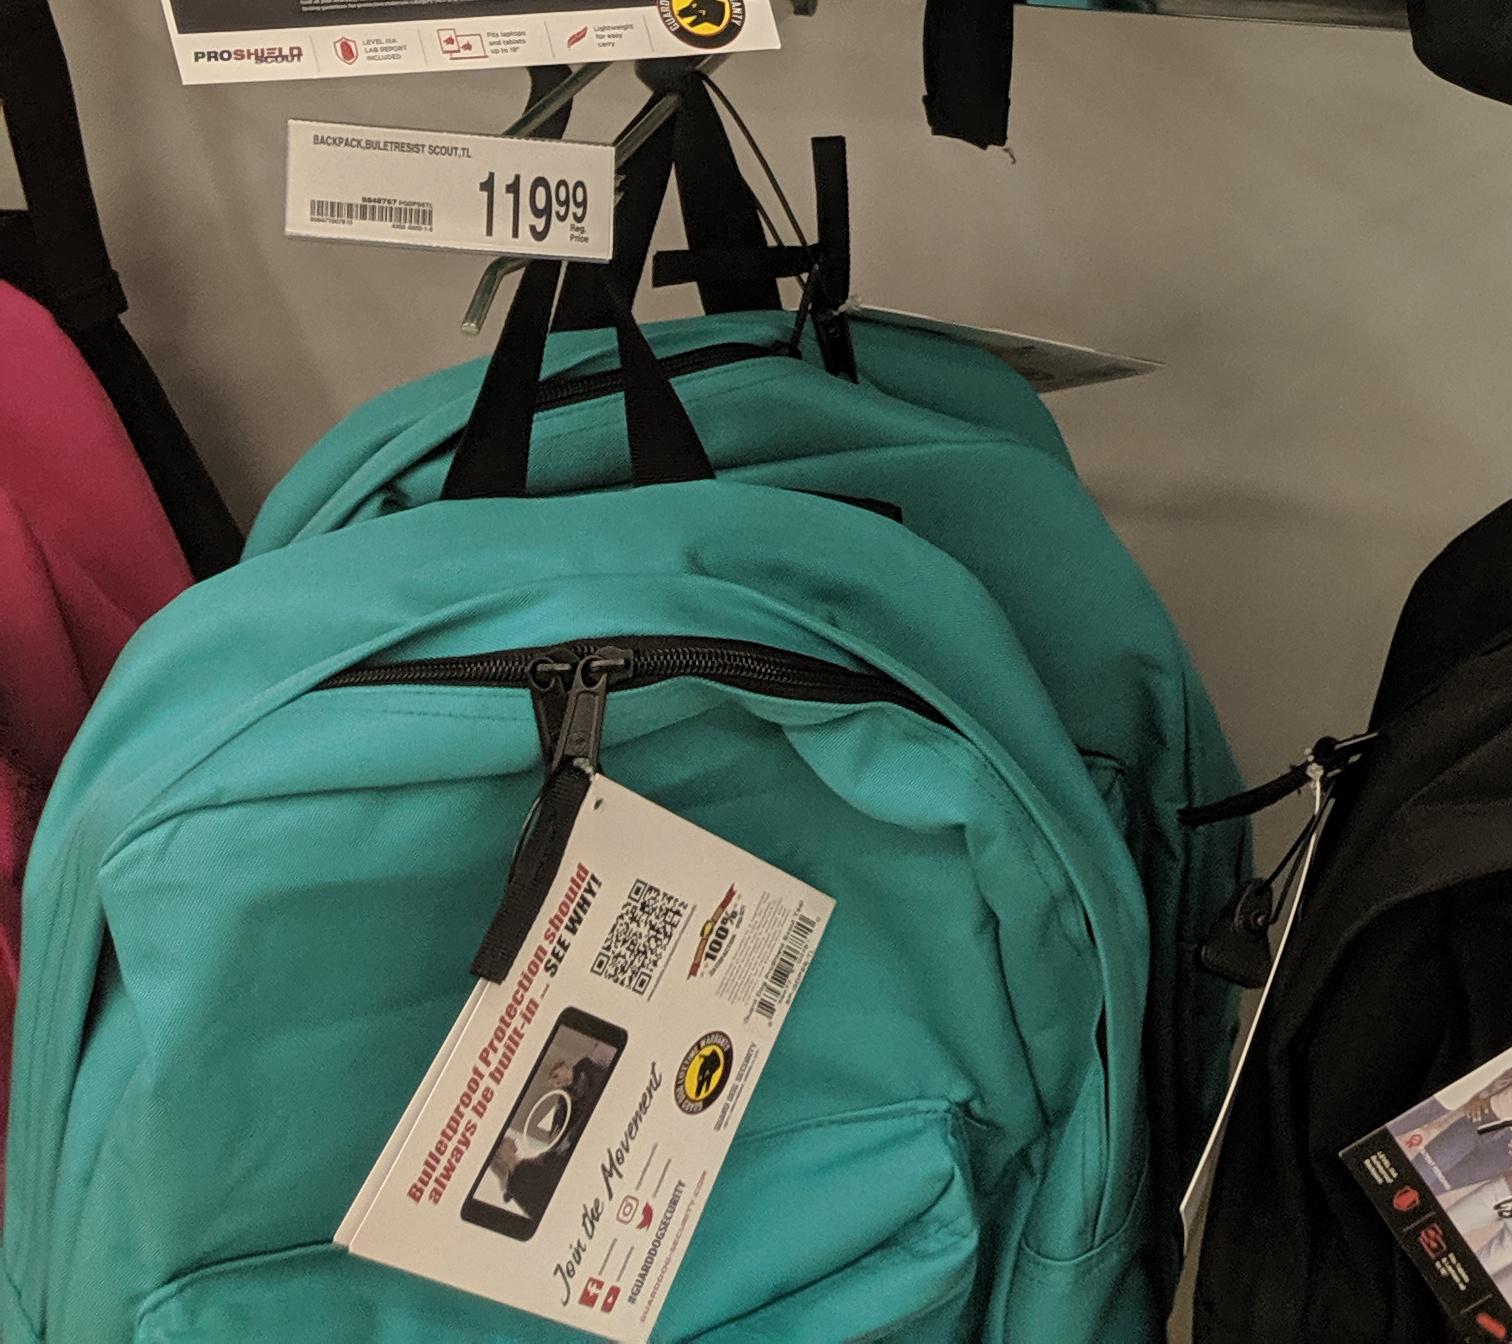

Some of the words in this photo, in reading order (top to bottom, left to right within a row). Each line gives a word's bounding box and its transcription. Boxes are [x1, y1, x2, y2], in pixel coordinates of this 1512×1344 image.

[659, 0, 680, 33] GUARD
[407, 1064, 484, 1204] Bulletproof
[479, 945, 547, 1064] Protection
[544, 862, 590, 944] should
[429, 1119, 478, 1205] always
[471, 1090, 494, 1120] be
[489, 998, 539, 1086] built-in
[544, 934, 571, 978] SEE
[567, 873, 602, 936] WHY!
[705, 910, 738, 962] 100%
[553, 1239, 586, 1306] Join
[582, 1198, 604, 1240] the
[600, 1061, 663, 1201] Movement
